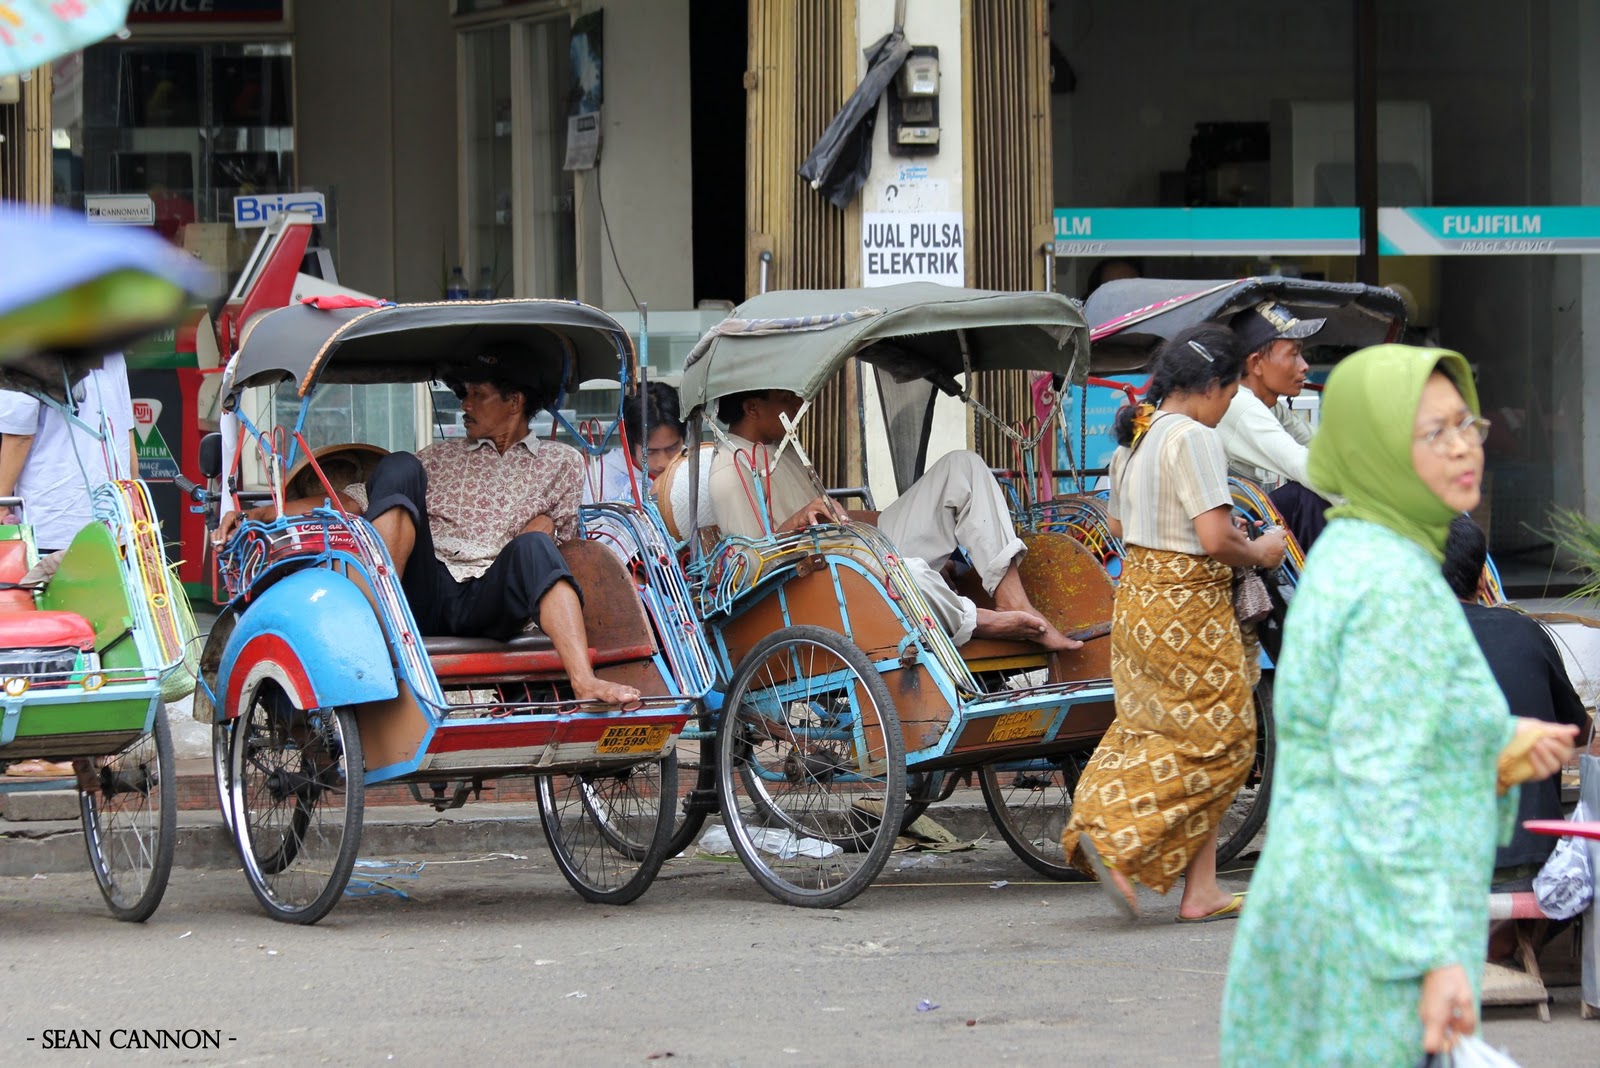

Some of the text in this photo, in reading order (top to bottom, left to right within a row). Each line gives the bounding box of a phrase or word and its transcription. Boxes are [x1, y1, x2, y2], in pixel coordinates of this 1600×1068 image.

[1442, 214, 1542, 235] FUJIFILM
[864, 223, 962, 248] JUAL PULSA
[1460, 240, 1557, 252] IMAGE SERVICE
[868, 252, 959, 274] ELEKTRIK
[997, 710, 1036, 727] BECAK
[607, 727, 649, 738] BECAK
